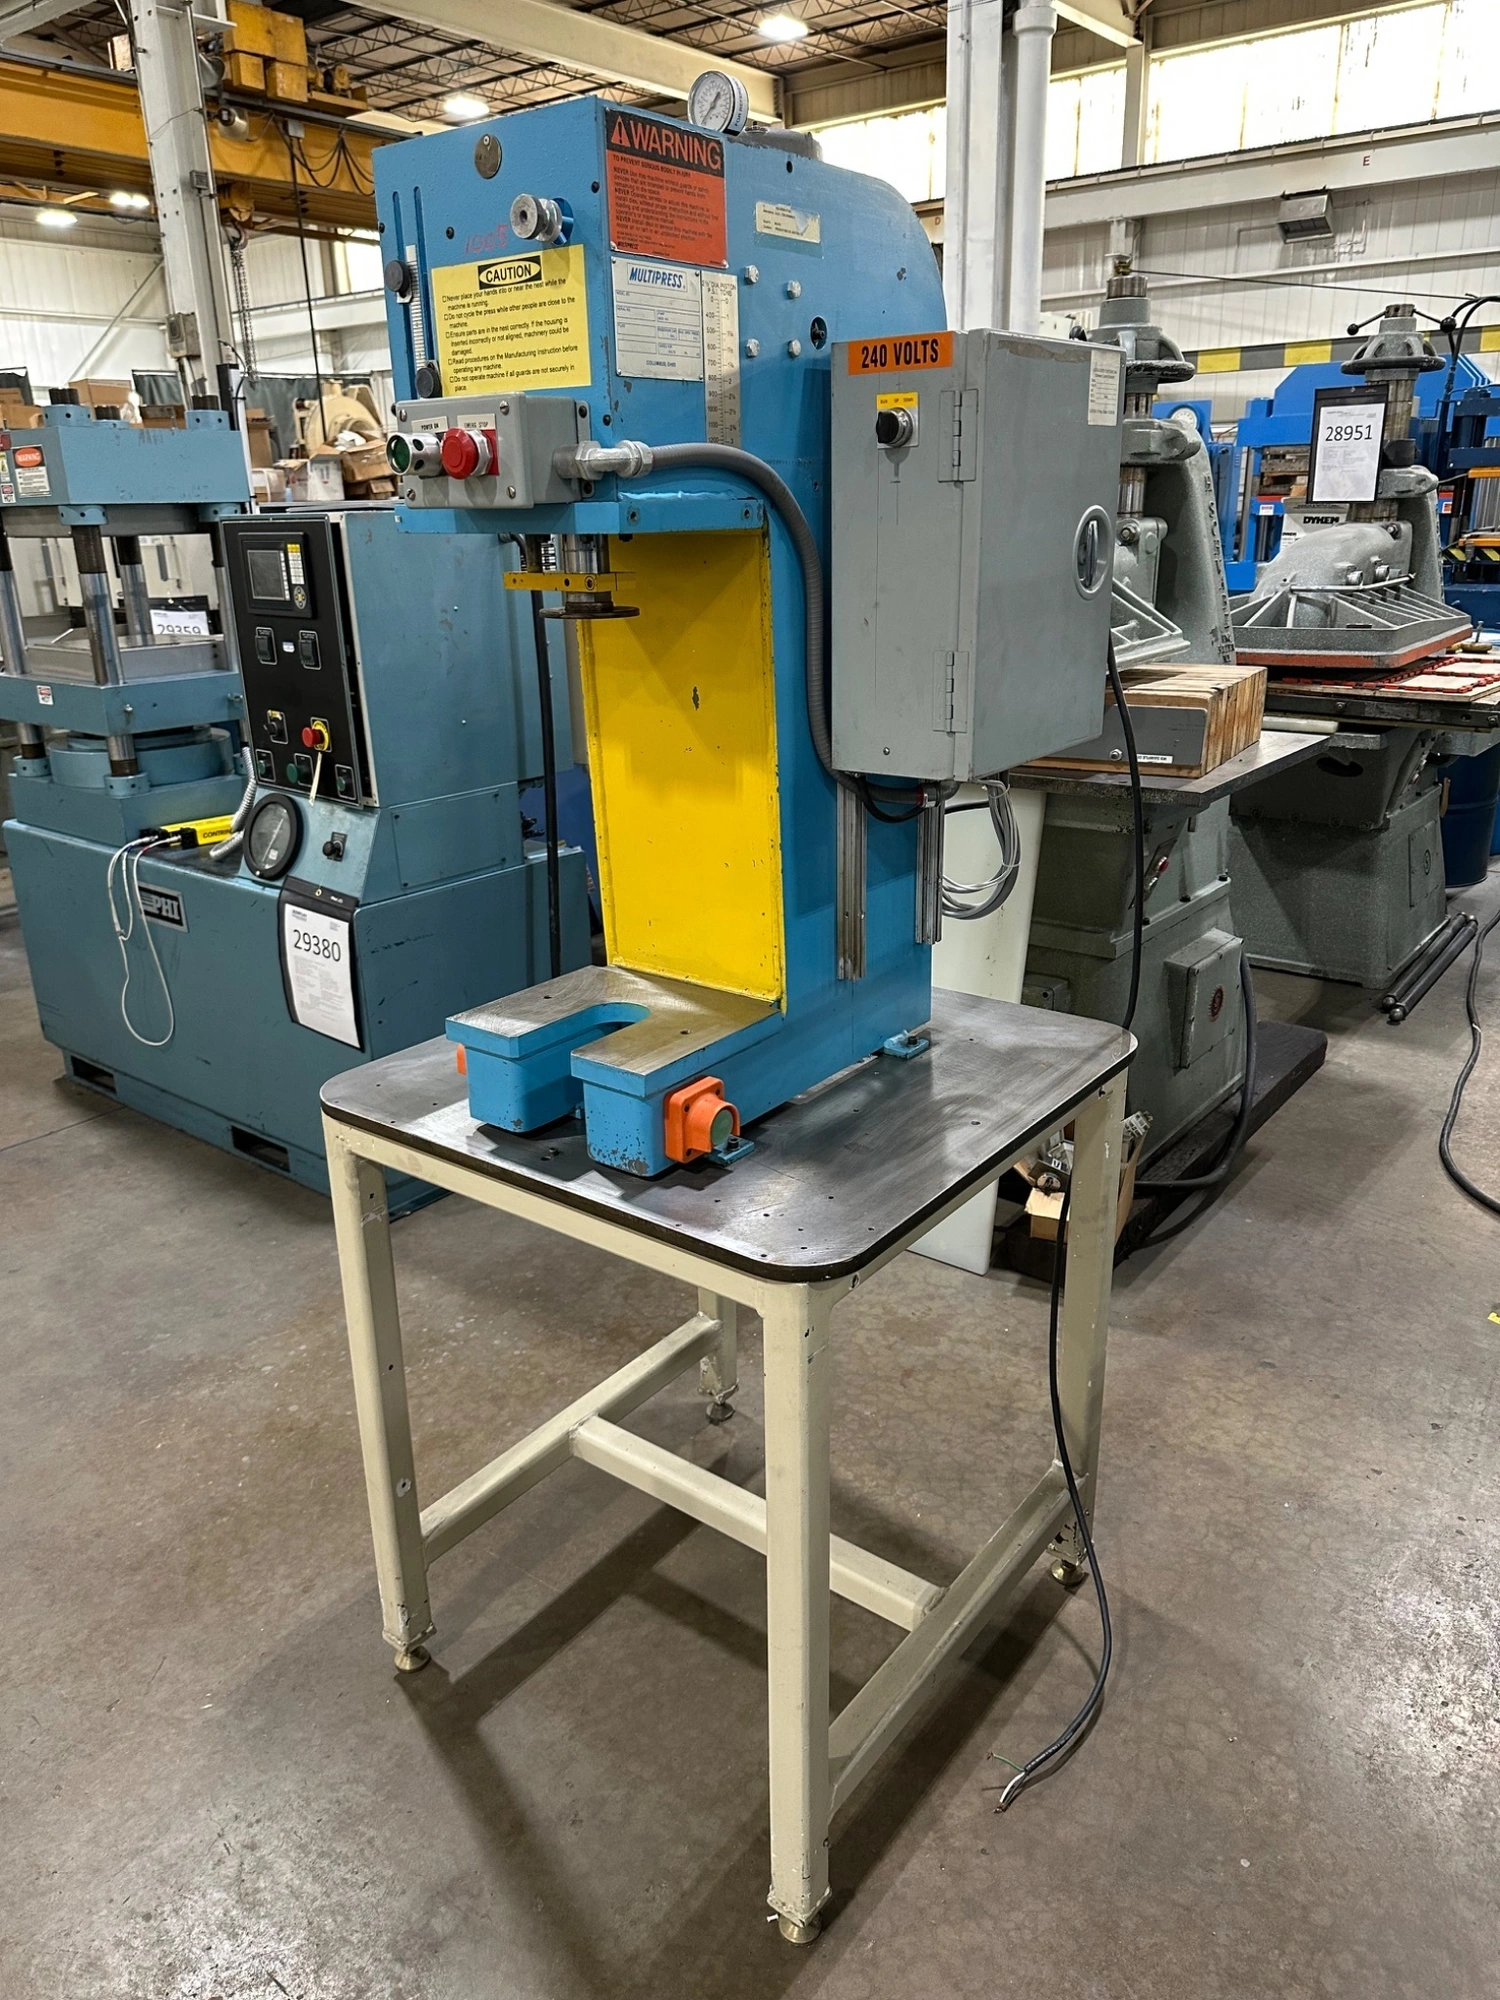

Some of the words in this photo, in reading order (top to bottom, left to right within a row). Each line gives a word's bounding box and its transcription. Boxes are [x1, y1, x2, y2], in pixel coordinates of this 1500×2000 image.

[630, 120, 720, 170] WARNING
[1363, 156, 1370, 166] E
[486, 264, 532, 282] CAUTION
[629, 267, 683, 288] MULTIPRESS
[460, 291, 472, 300] place
[521, 301, 537, 310] people
[544, 318, 562, 326] housing
[523, 329, 547, 339] machinery
[464, 354, 489, 364] procedures
[504, 349, 536, 360] Manufacturing
[862, 344, 887, 368] 240
[894, 338, 939, 365] VOLTS
[515, 369, 531, 377] guards
[549, 364, 568, 373] securely
[1325, 424, 1372, 441] 28951
[152, 894, 180, 920] PHI
[293, 929, 341, 962] 29380
